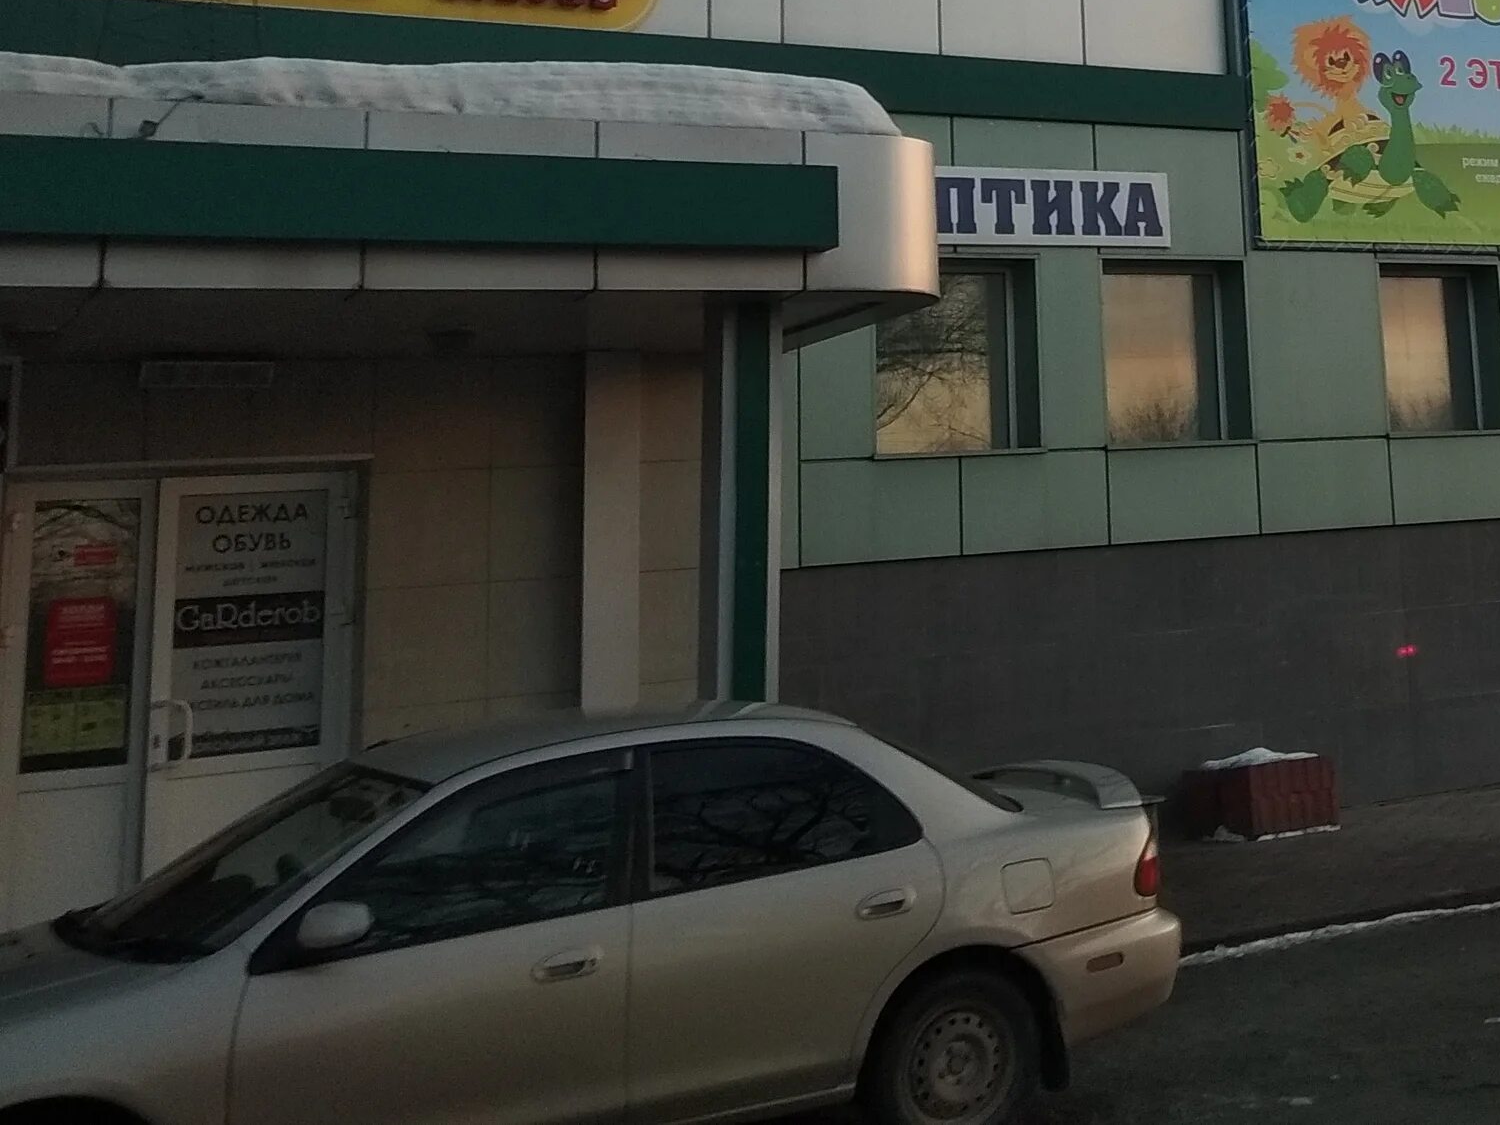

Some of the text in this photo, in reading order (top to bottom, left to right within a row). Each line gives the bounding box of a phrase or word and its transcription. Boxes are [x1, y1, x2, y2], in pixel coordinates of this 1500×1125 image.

[1439, 56, 1458, 87] 2
[1461, 157, 1499, 169] режим
[195, 503, 309, 526] ОДЕЖДА
[212, 532, 292, 554] ОБУВЬ
[176, 600, 321, 631] GaRderob
